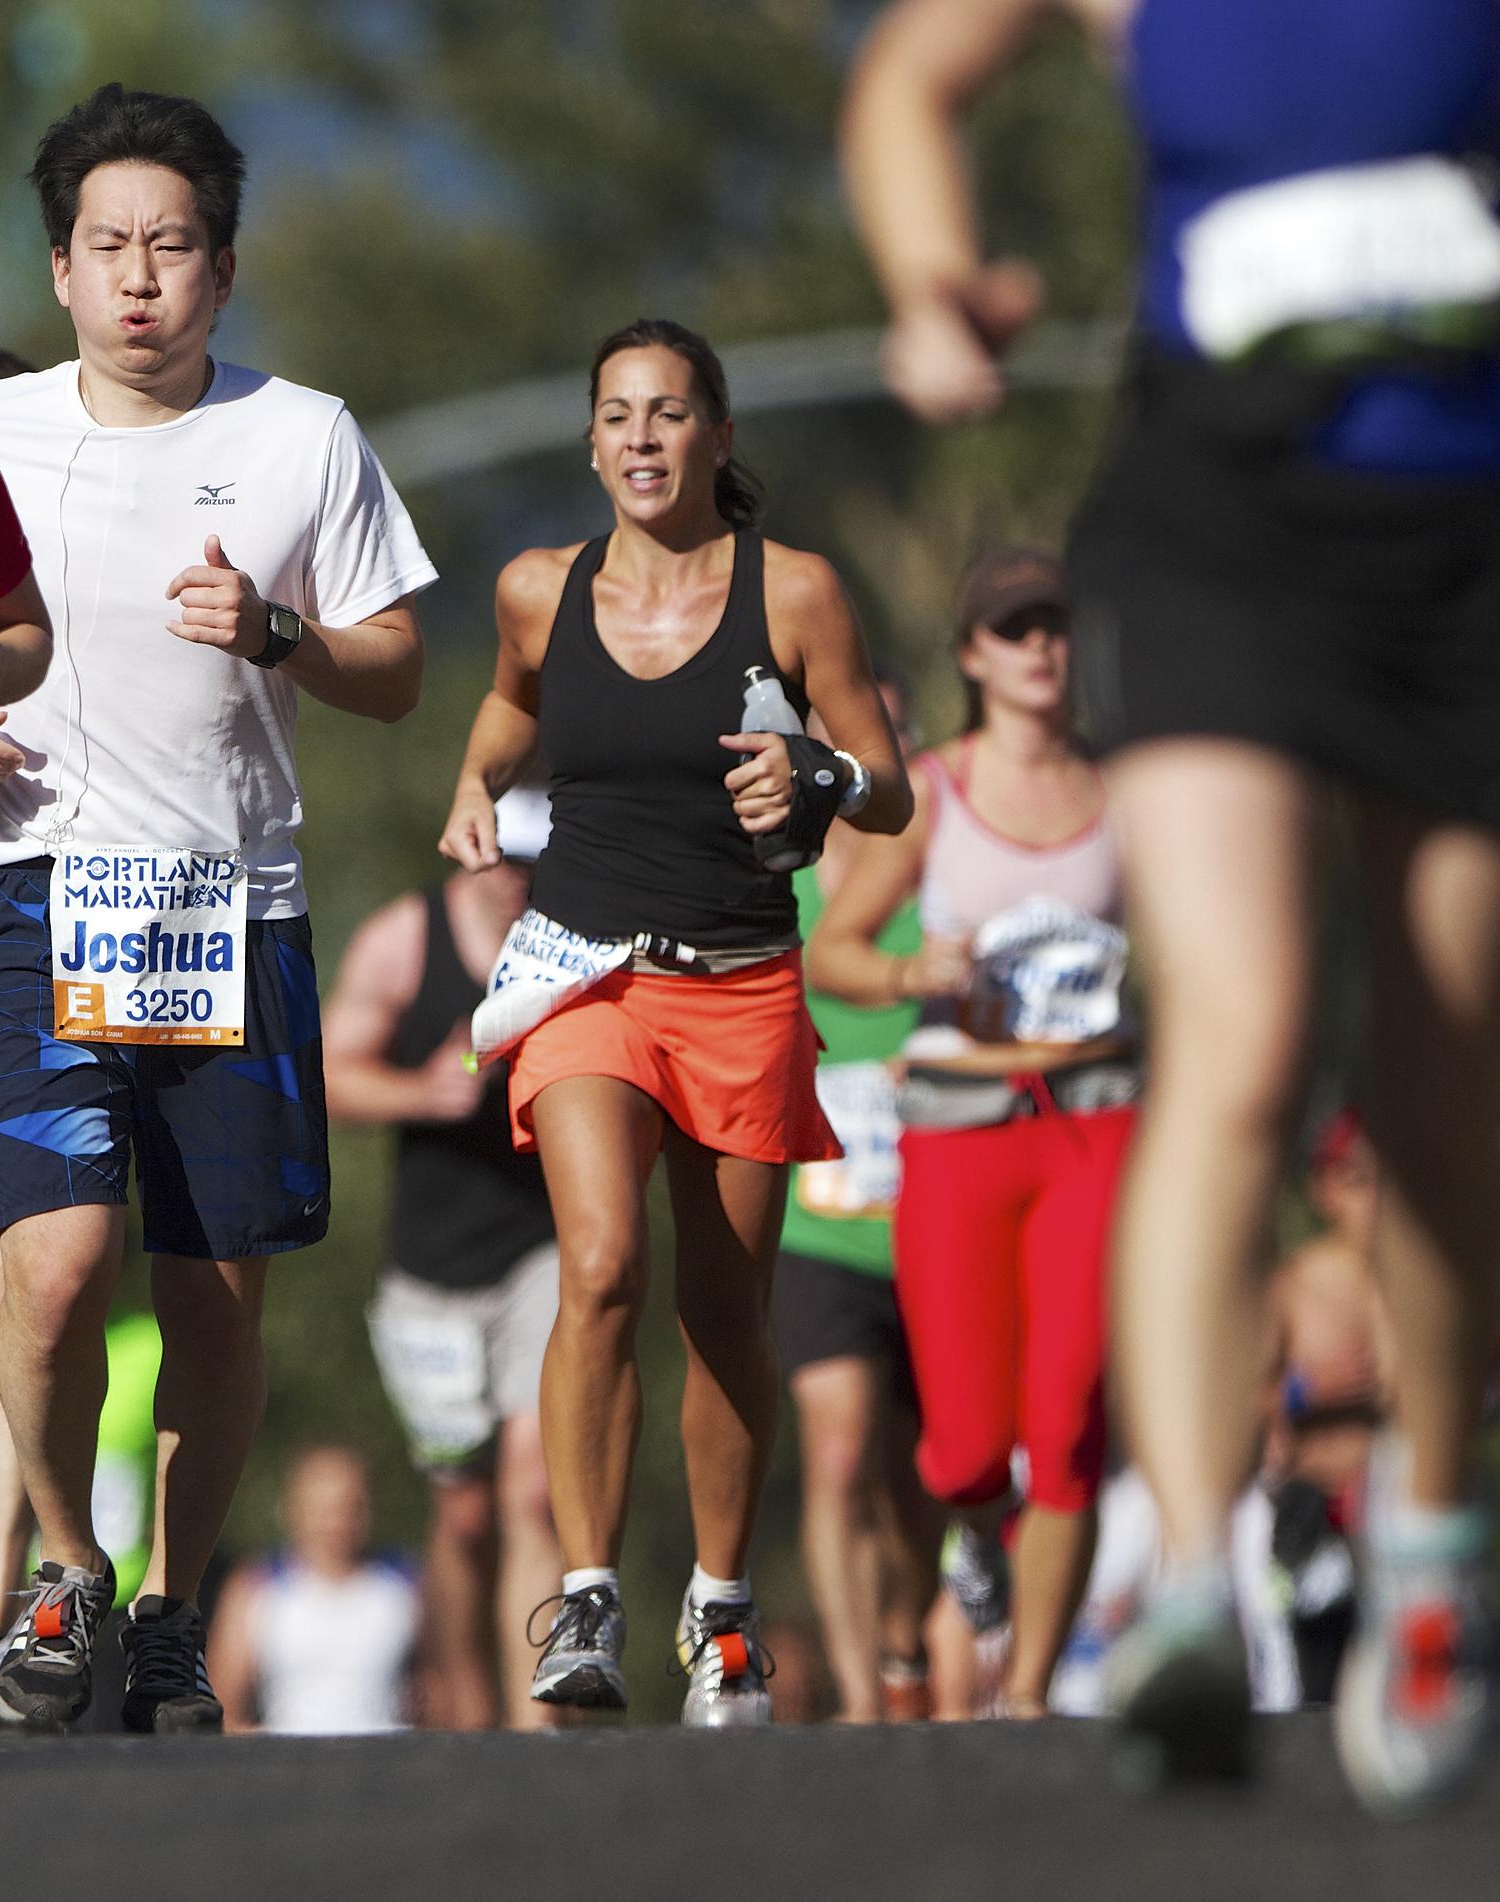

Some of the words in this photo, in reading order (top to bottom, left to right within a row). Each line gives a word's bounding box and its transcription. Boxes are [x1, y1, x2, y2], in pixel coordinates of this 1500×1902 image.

[65, 855, 235, 882] PORTLAND
[64, 884, 232, 911] MARATHON
[60, 920, 233, 974] Joshua
[67, 986, 94, 1020] E
[126, 988, 213, 1022] 3250
[67, 1028, 90, 1036] JOSHUA
[210, 1029, 221, 1040] M
